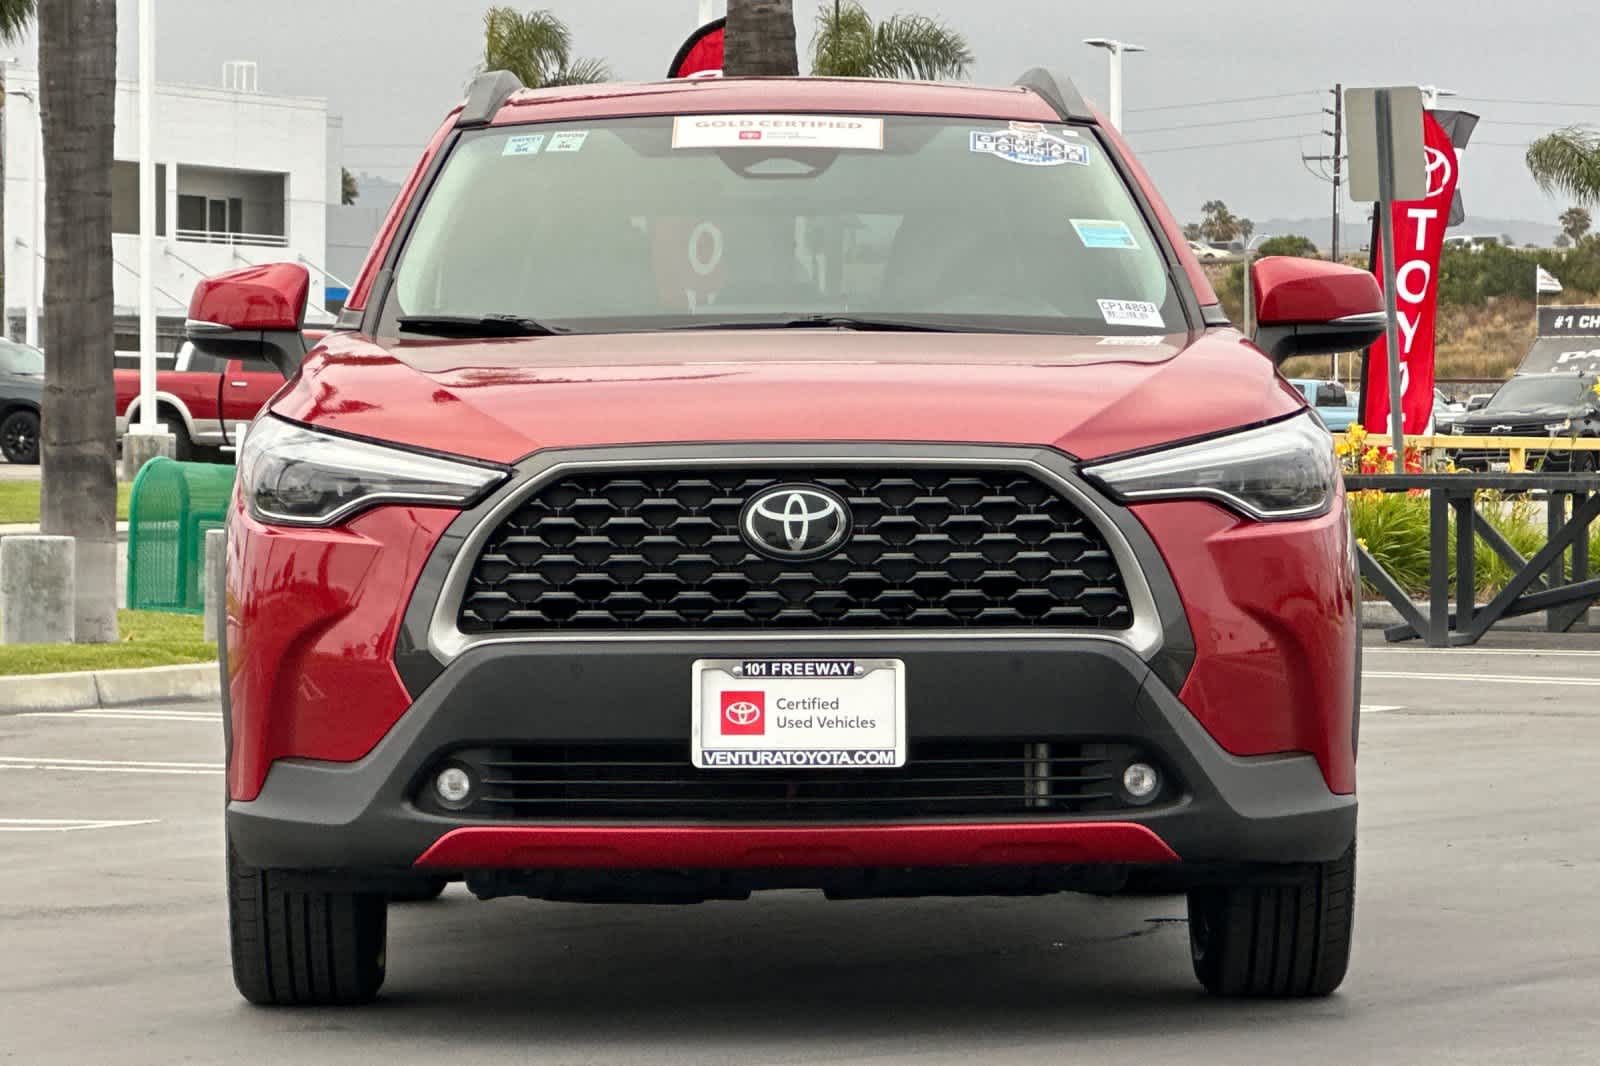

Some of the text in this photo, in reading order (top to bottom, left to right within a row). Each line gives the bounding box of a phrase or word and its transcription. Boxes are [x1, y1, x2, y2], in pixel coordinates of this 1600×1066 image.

[695, 119, 863, 130] GOLD CERTIFIED
[1554, 314, 1600, 329] #1 CH
[744, 662, 851, 676] 101 FREEWAY
[775, 697, 840, 711] Certified
[775, 716, 877, 729] Used Vehicles
[703, 750, 895, 765] VENTURATOYOTA.COM
